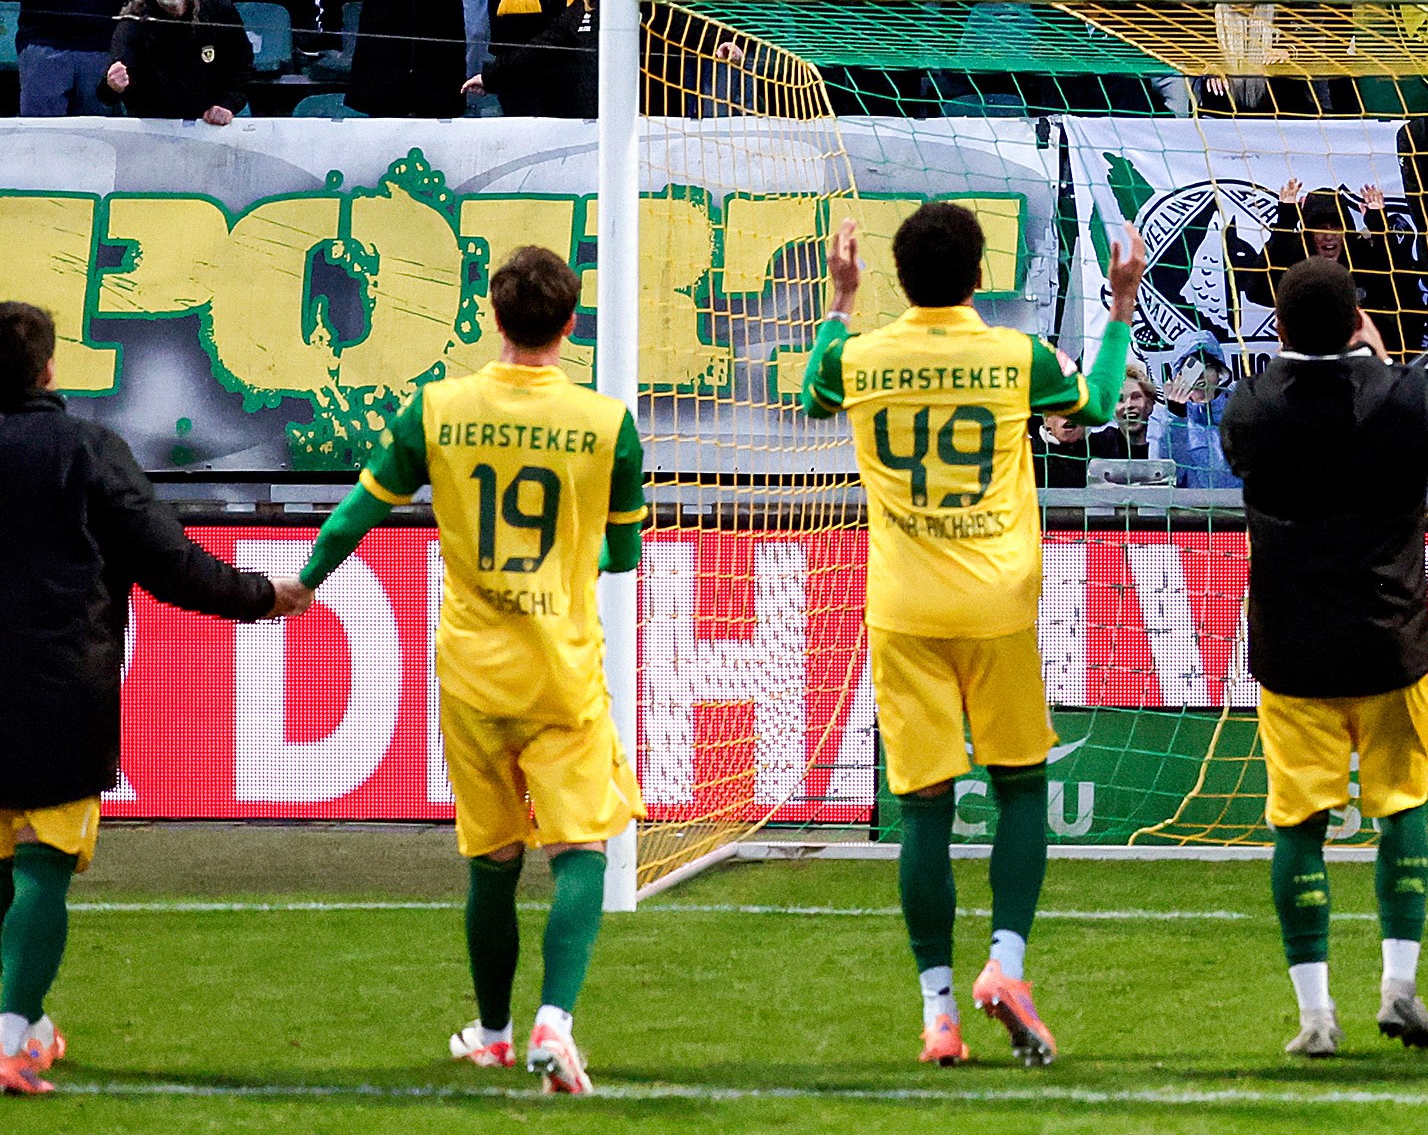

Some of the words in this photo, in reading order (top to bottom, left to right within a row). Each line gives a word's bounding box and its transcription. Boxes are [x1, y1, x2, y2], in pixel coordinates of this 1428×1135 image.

[856, 365, 1019, 391] BIERSTEKER
[438, 423, 598, 454] BIERSTEKER
[874, 406, 997, 509] 49
[470, 463, 563, 574] 19
